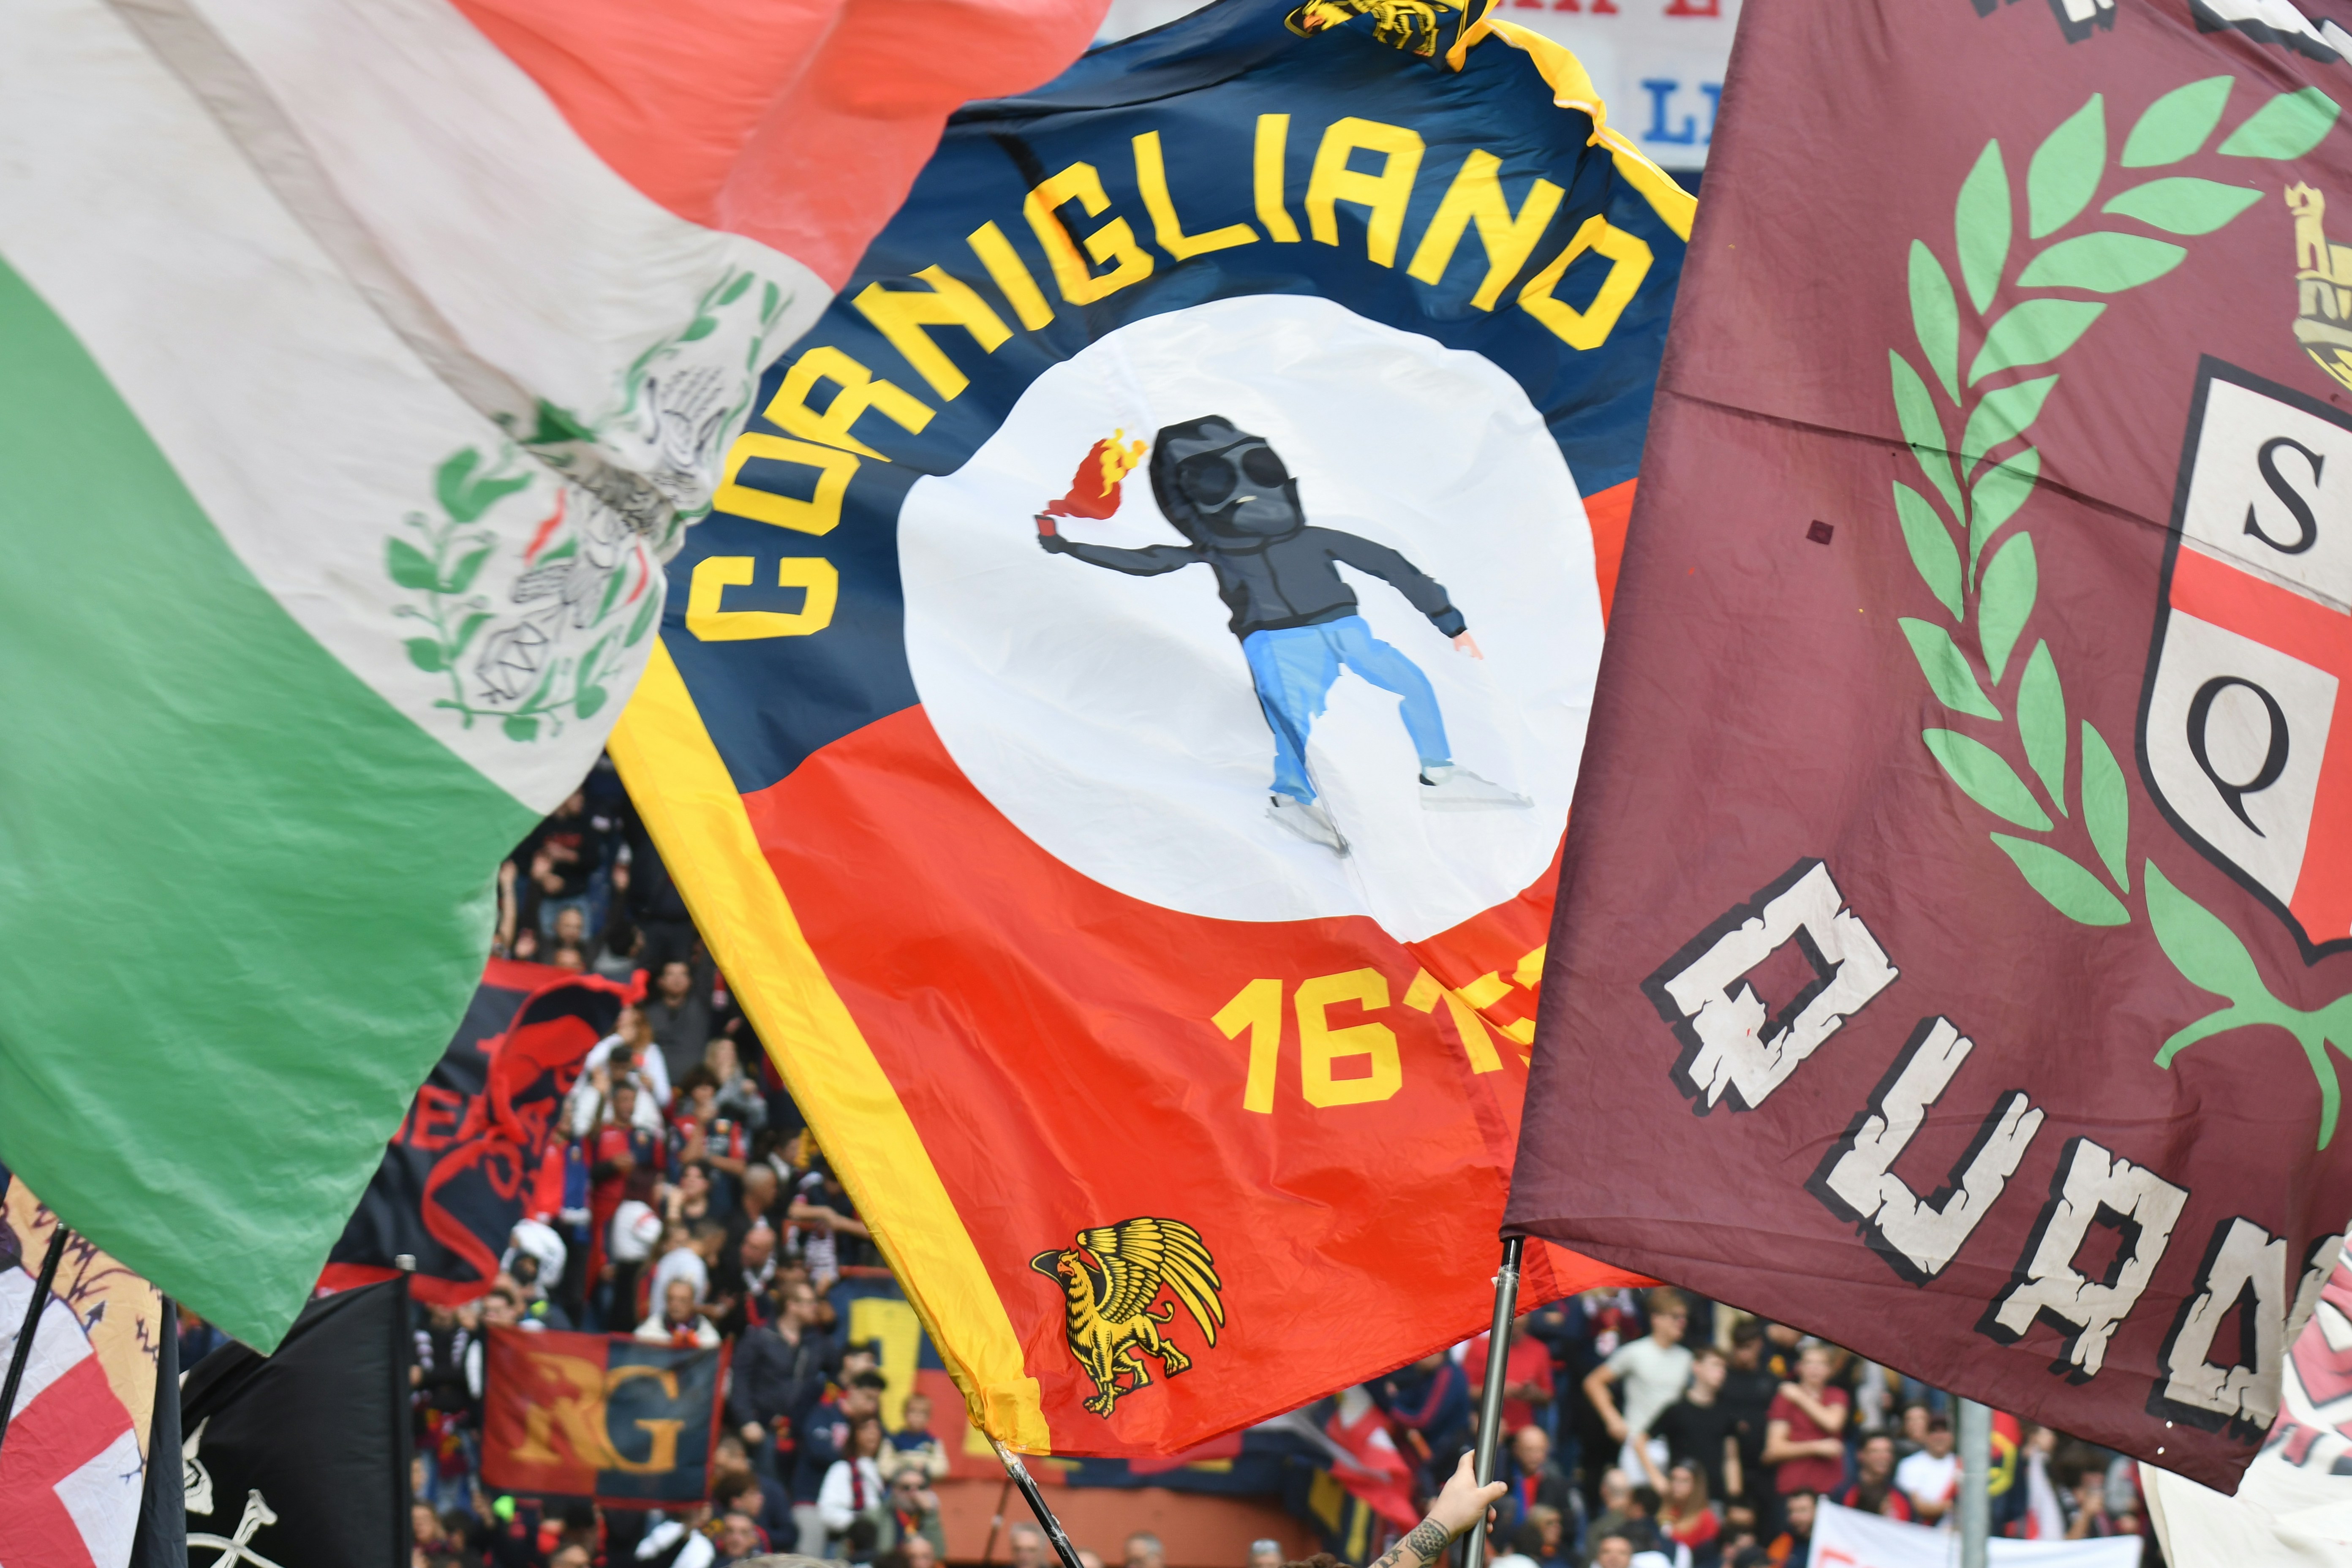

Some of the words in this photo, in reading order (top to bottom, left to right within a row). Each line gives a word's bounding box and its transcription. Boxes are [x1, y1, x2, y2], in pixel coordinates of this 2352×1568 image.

[685, 113, 1654, 641] CORNIGLIANO
[2243, 436, 2325, 554] S
[2186, 675, 2289, 838] Q
